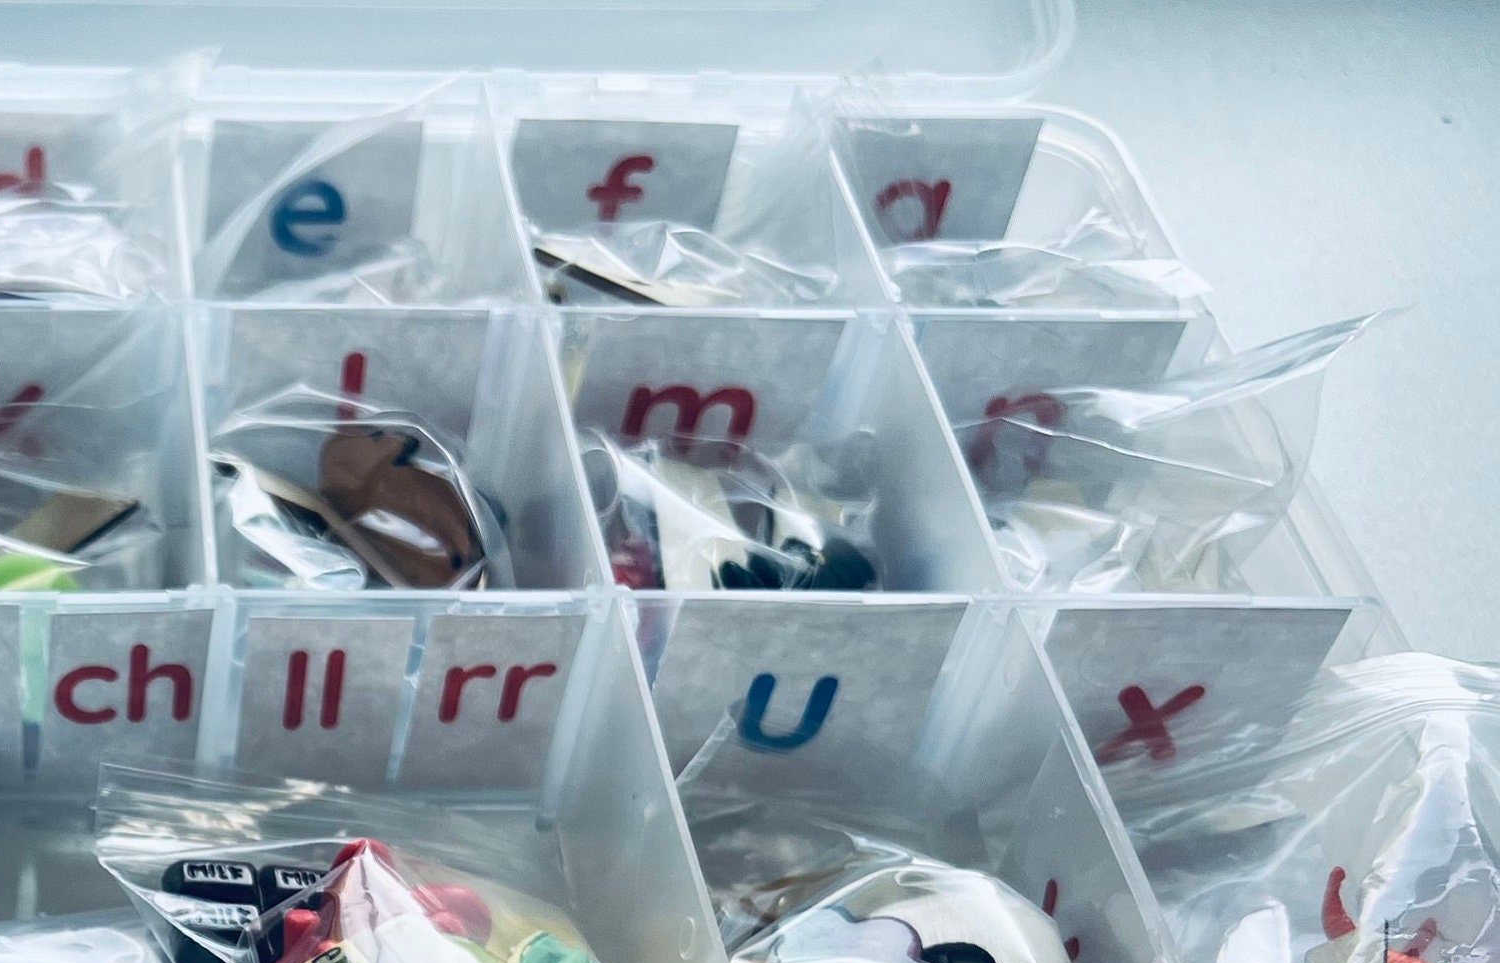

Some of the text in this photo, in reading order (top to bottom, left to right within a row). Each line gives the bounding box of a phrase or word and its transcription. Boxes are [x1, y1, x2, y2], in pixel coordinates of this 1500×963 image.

[268, 177, 348, 257] e
[586, 155, 656, 232] f
[621, 384, 757, 468] m
[53, 643, 196, 725] ch
[282, 647, 349, 731] ll
[437, 662, 558, 724] rr
[737, 671, 841, 753] u
[1097, 684, 1206, 762] x
